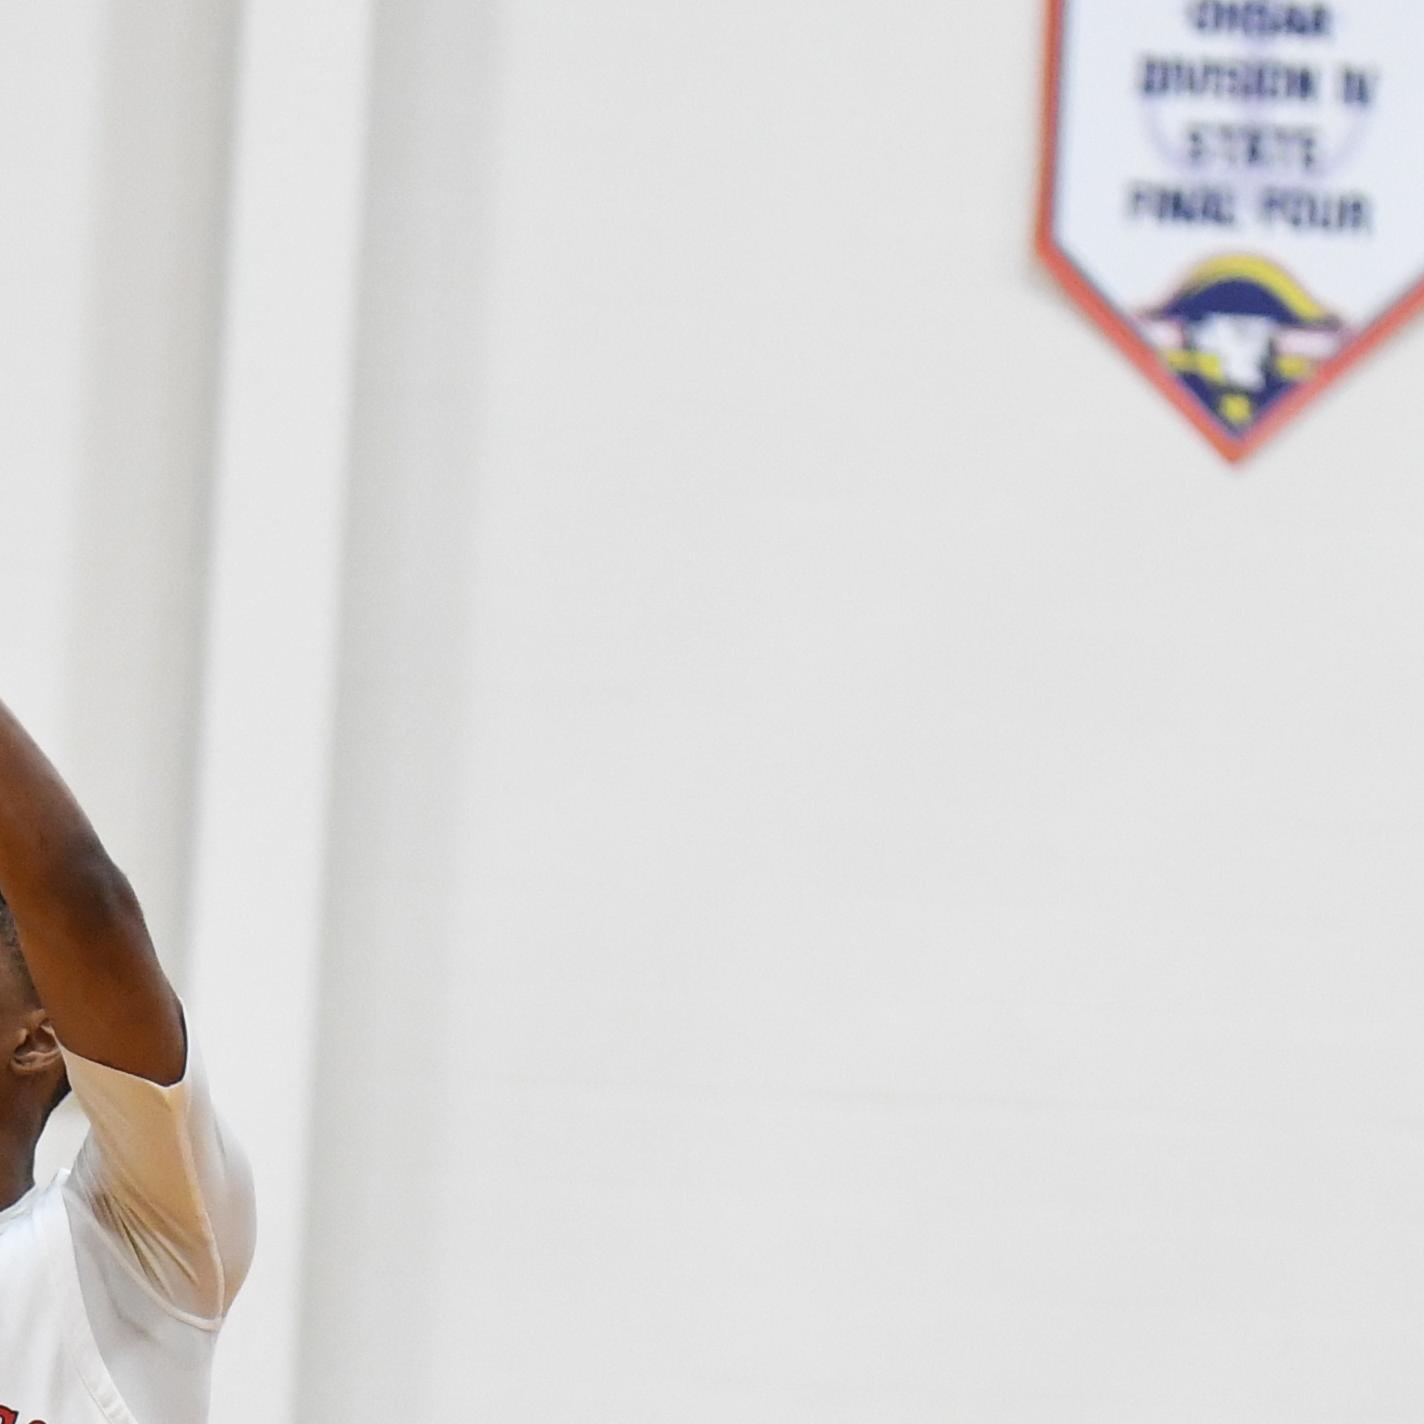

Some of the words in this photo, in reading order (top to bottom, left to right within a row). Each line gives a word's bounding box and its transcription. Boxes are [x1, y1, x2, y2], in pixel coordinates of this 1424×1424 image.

[1141, 57, 1316, 98] DIVISION
[1185, 125, 1318, 168] STATE
[1130, 184, 1236, 225] FINAL
[1260, 188, 1369, 230] FOUR
